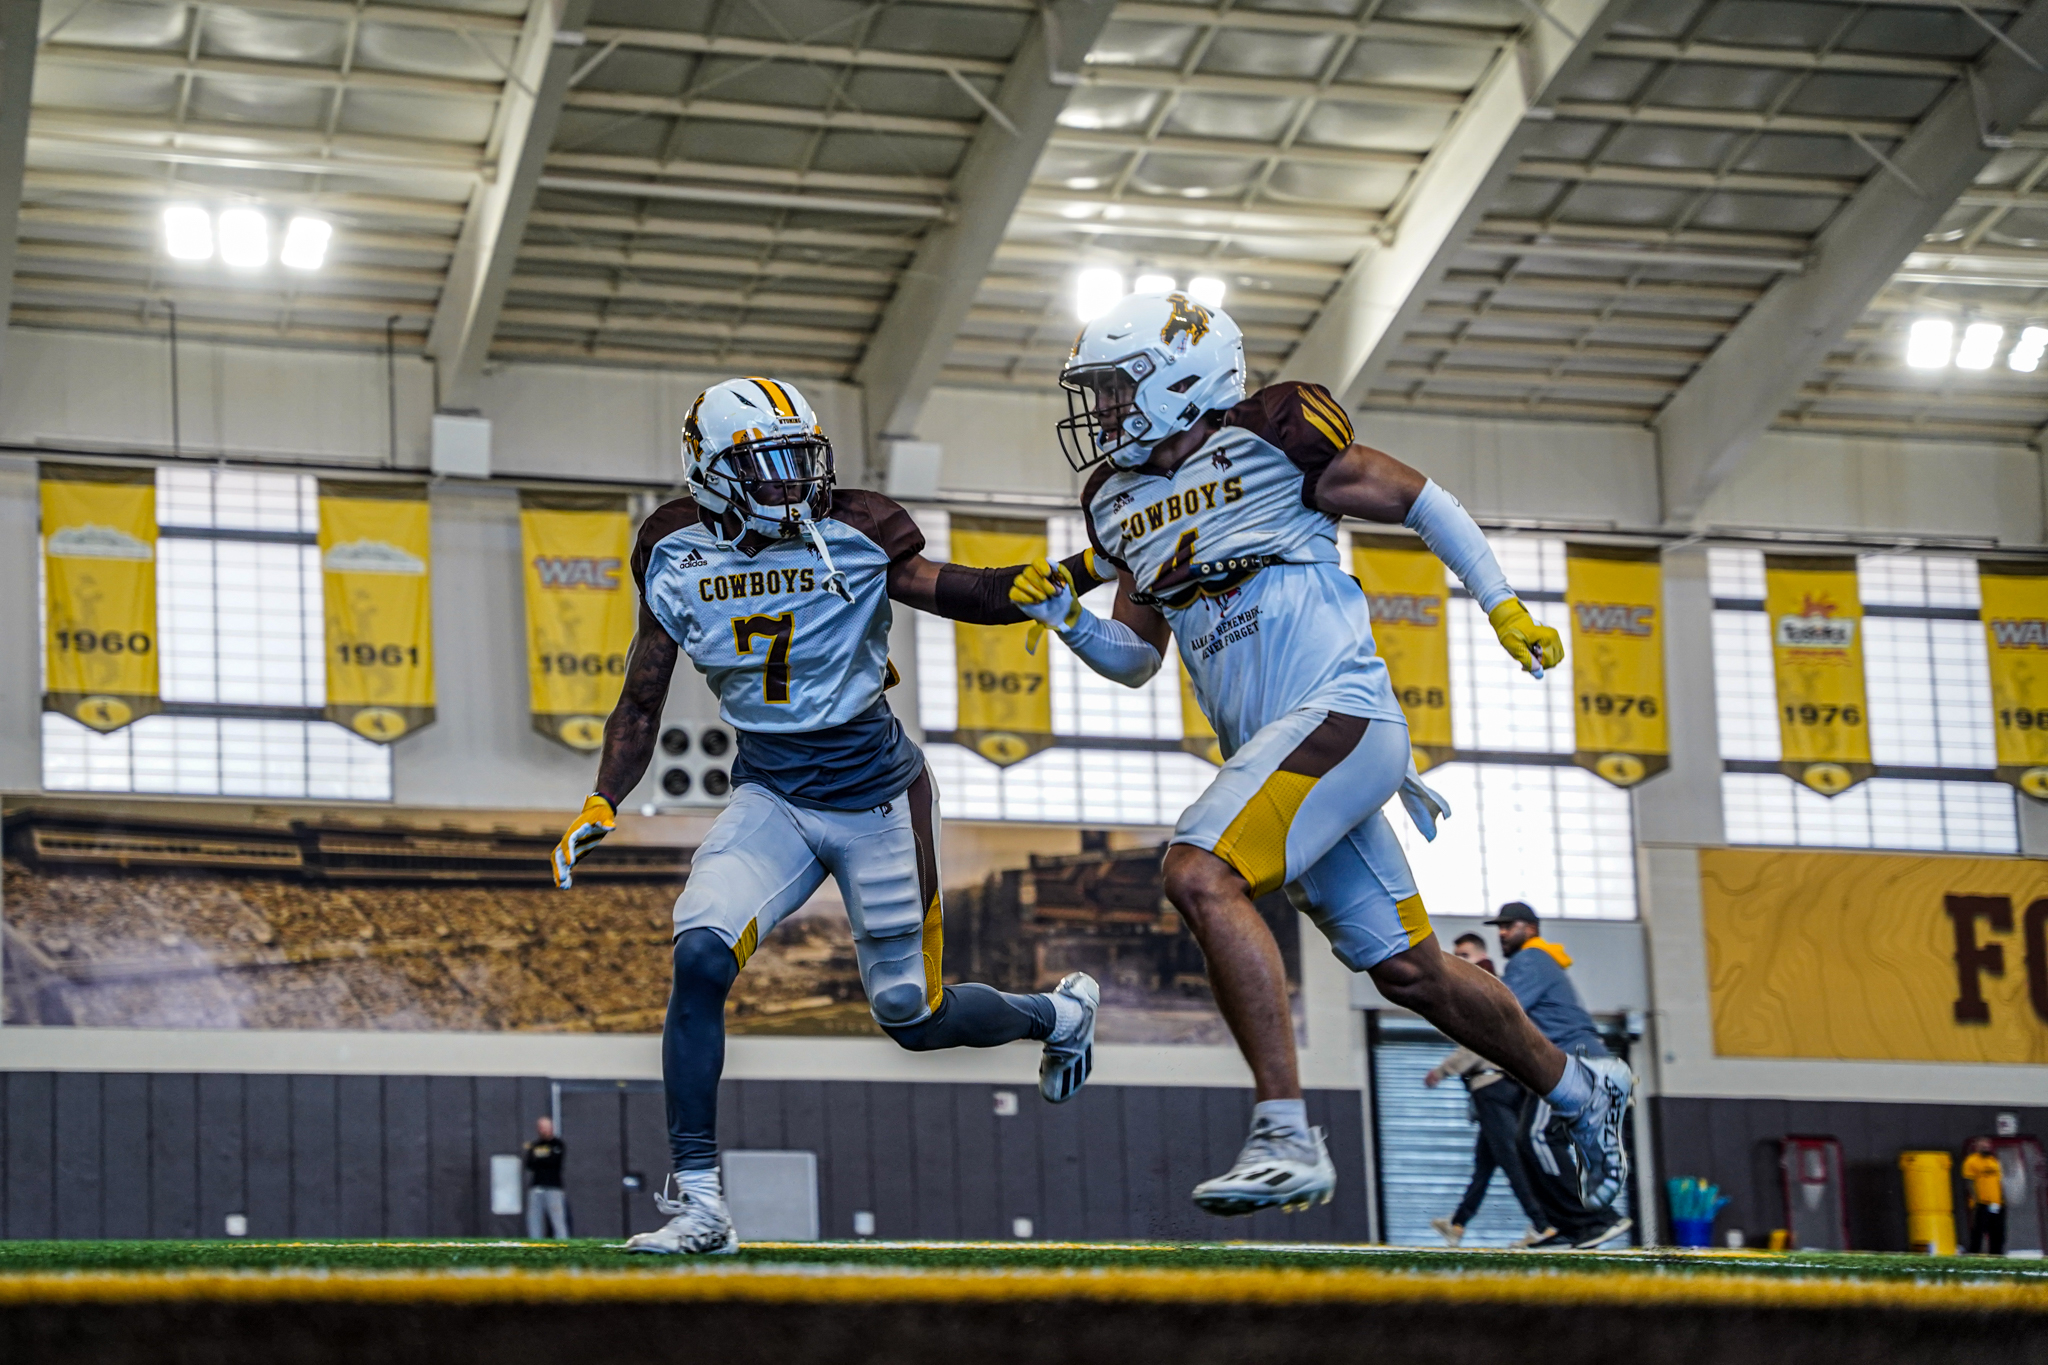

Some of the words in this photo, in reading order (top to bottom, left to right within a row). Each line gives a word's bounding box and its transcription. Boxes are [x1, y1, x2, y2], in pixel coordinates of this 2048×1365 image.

[533, 555, 623, 591] WAC
[679, 558, 708, 570] adidas
[698, 567, 816, 603] COWBOYS
[1574, 601, 1655, 638] WAC
[55, 628, 152, 656] 1960
[1224, 620, 1260, 647] FORGET
[337, 643, 419, 668] 1961
[540, 652, 625, 677] 1966
[730, 610, 796, 705] 7
[963, 669, 1044, 695] 1967
[1579, 692, 1658, 718] 1976
[1784, 702, 1861, 727] 1976
